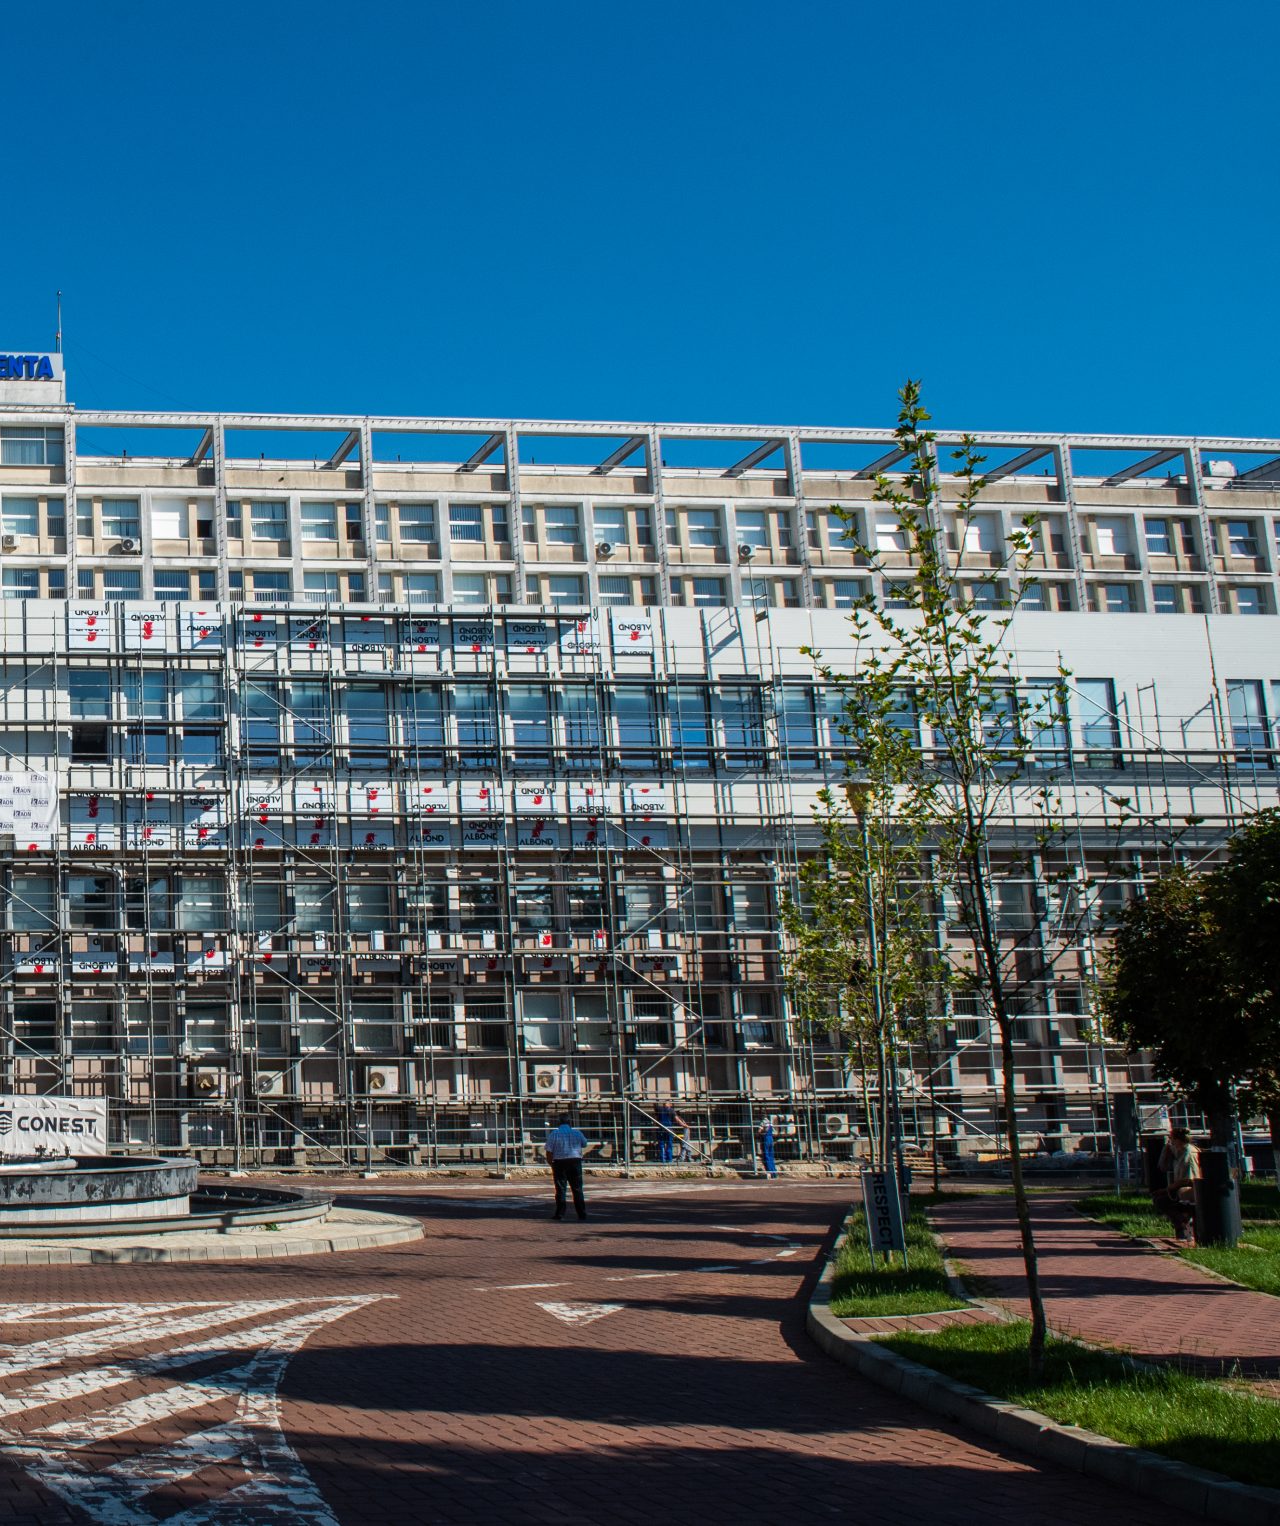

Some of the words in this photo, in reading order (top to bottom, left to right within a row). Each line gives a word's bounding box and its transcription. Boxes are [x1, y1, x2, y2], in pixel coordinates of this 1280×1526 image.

[352, 643, 385, 651] ALBOND
[17, 1116, 97, 1134] CONEST
[872, 1174, 893, 1247] RESPECT
